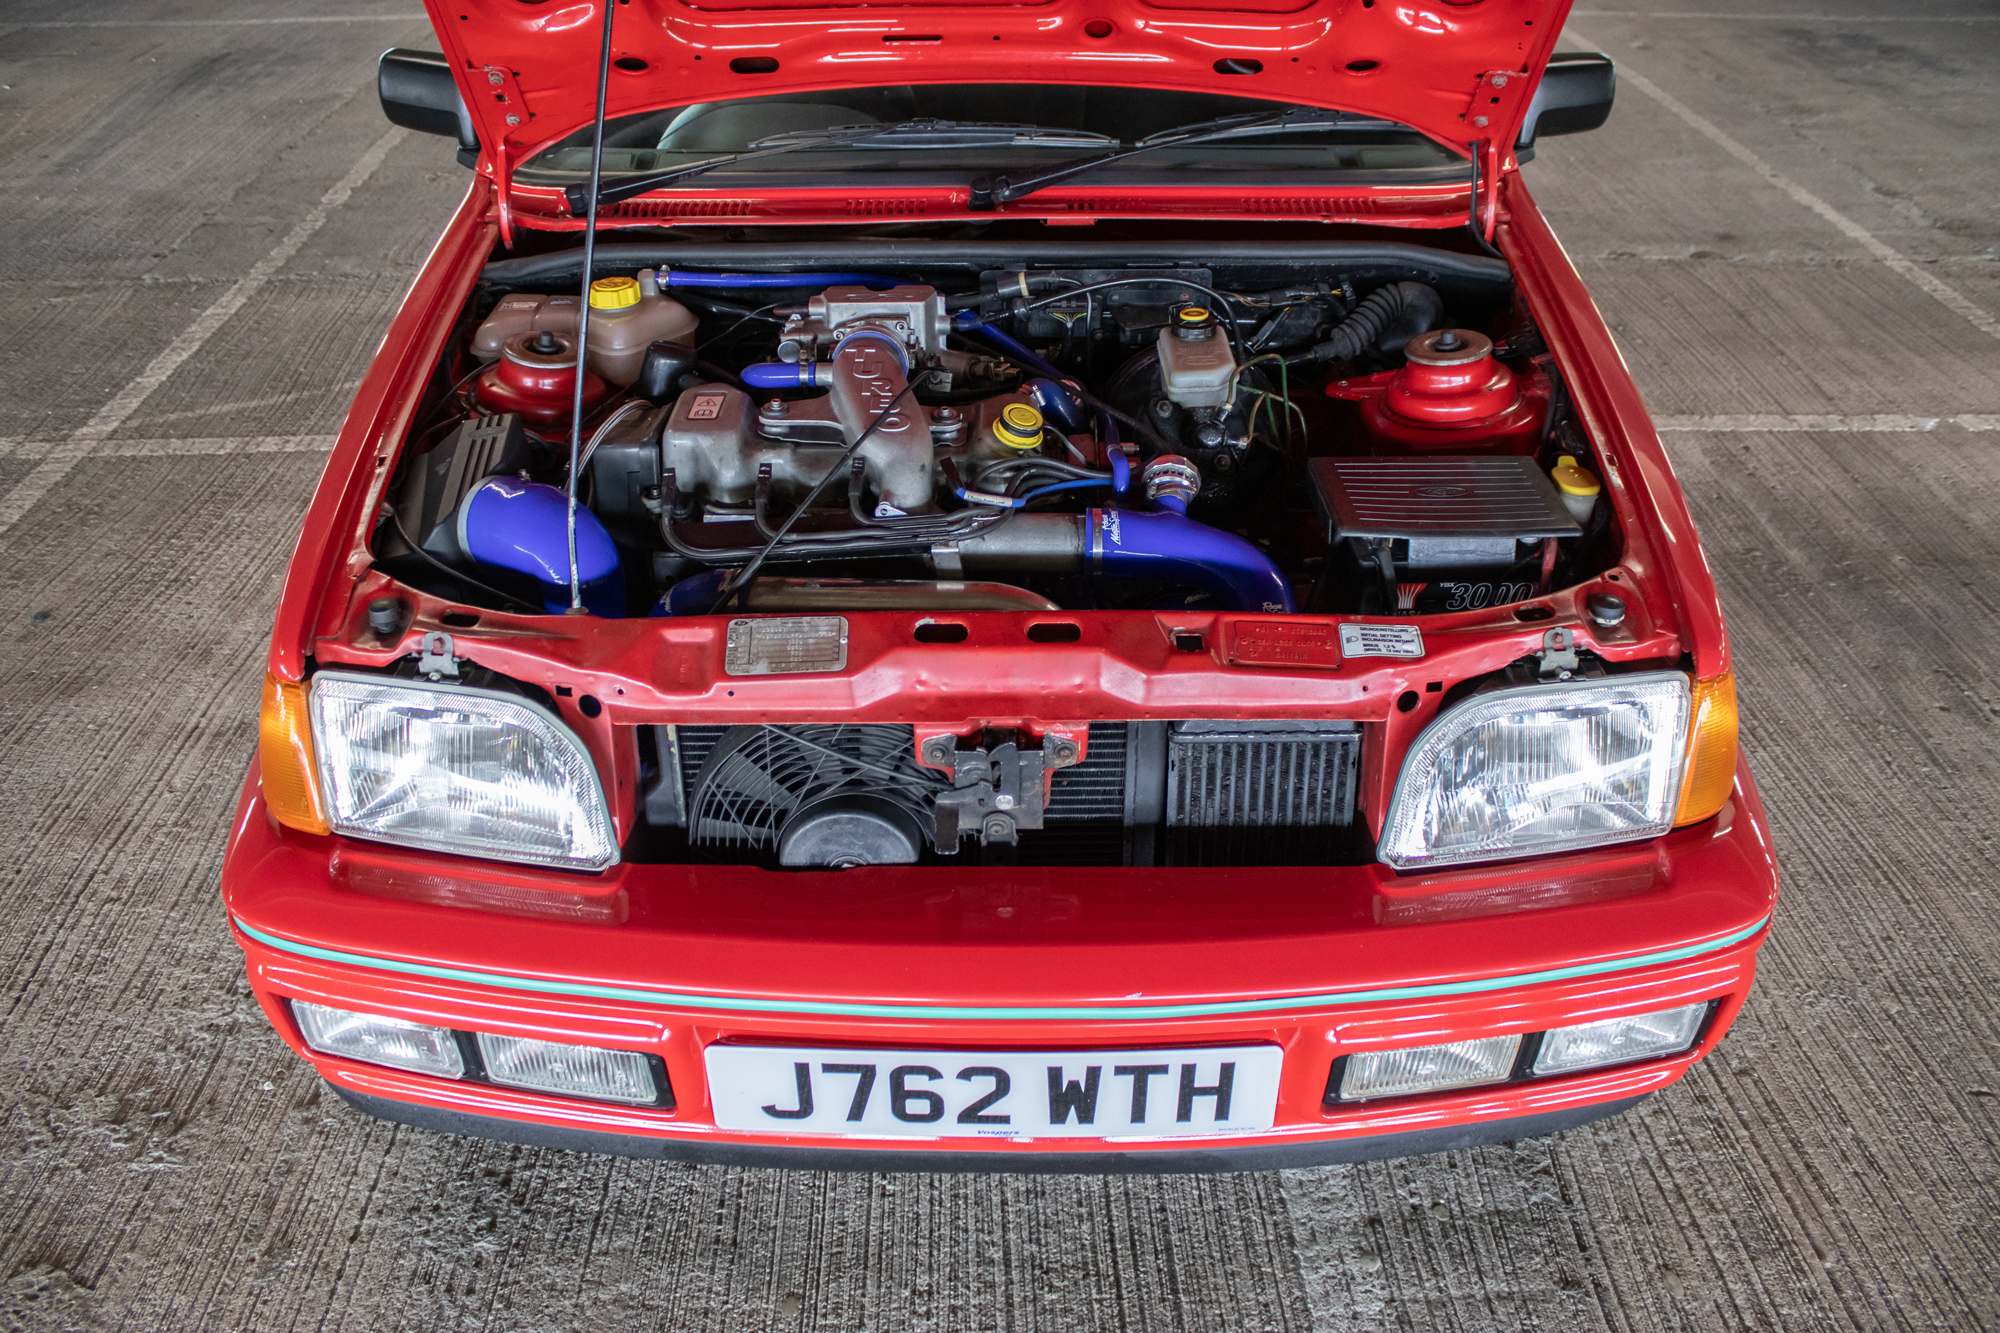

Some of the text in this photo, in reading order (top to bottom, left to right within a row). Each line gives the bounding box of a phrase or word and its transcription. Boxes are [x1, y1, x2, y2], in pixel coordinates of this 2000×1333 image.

[845, 347, 911, 432] TURBO
[1446, 583, 1533, 610] 3000
[761, 1062, 1236, 1125] J762 WTH
